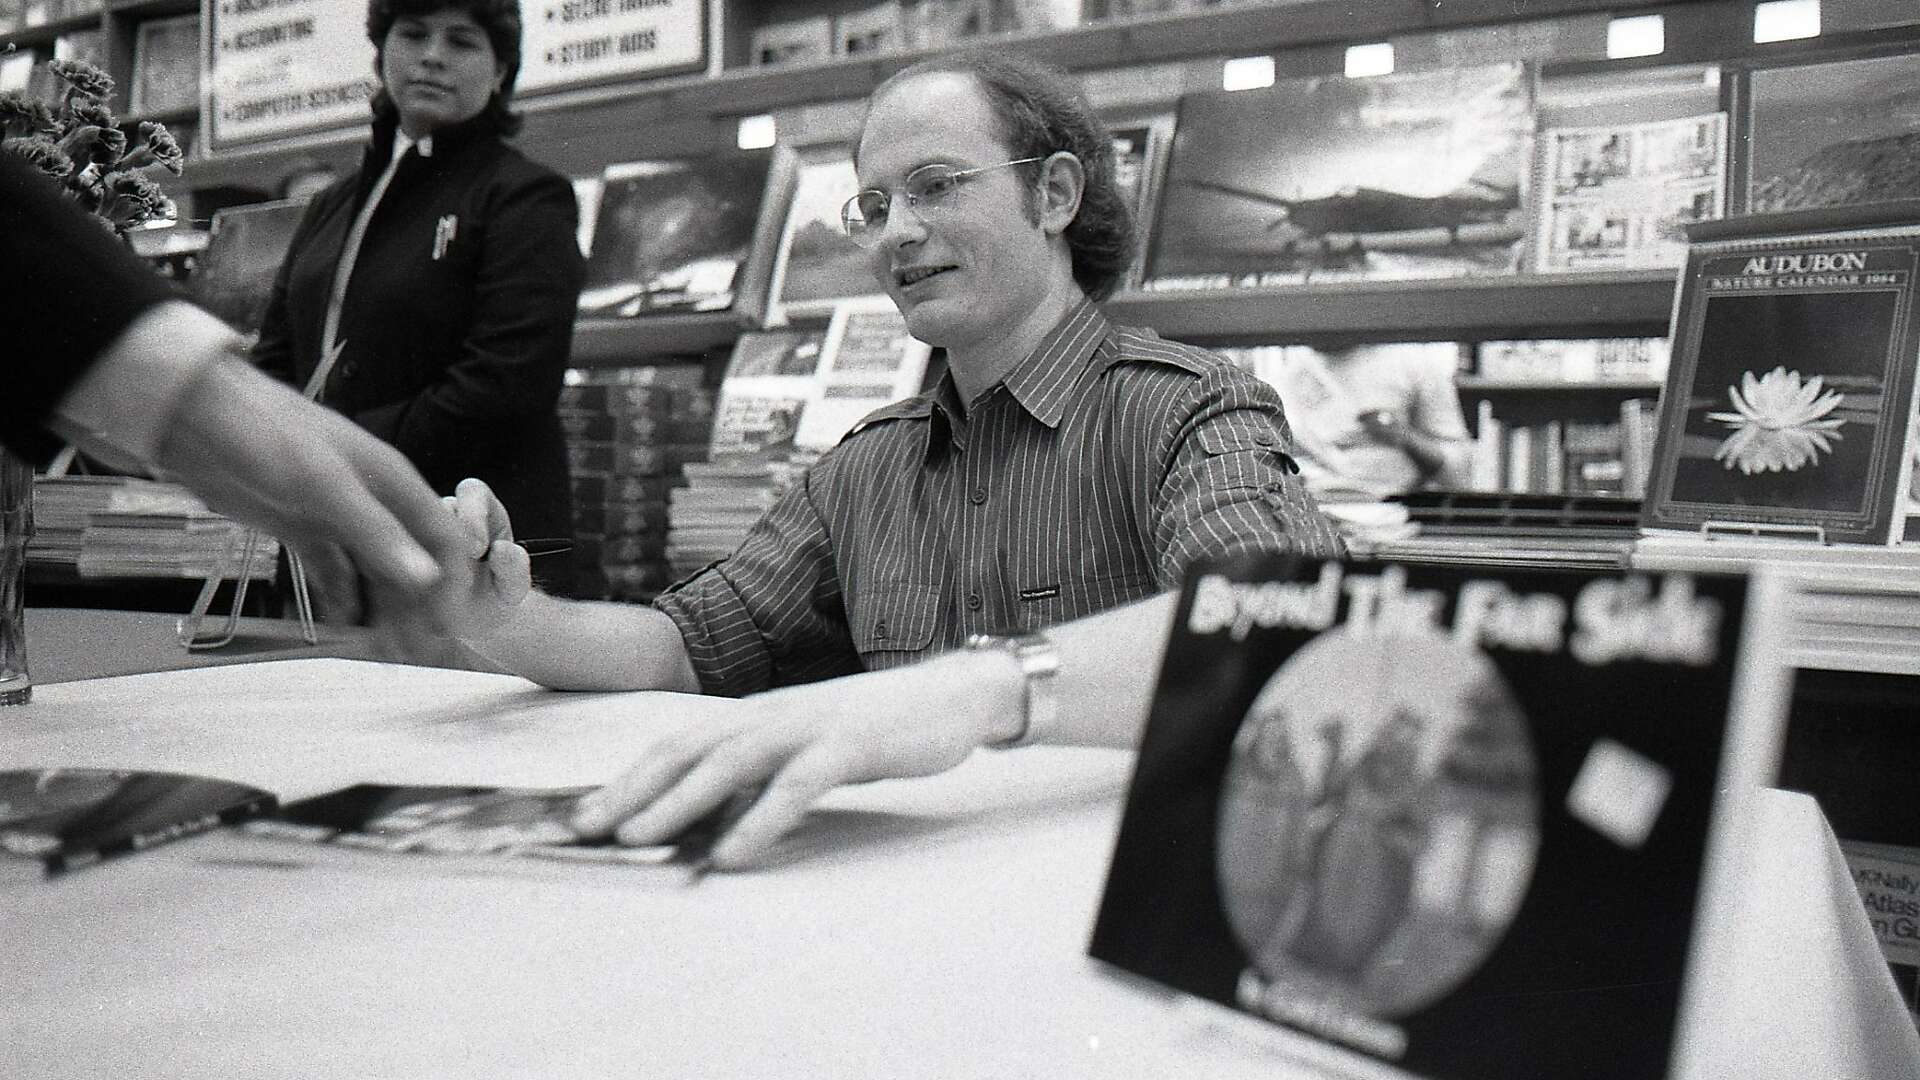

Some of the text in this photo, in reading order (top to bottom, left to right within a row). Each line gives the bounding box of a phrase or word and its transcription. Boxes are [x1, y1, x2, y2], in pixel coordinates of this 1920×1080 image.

[561, 29, 656, 64] STUDY AIDS
[235, 94, 301, 121] COMPUTER
[1742, 252, 1868, 275] AUDUBON
[1710, 277, 1773, 290] NATURE
[1776, 274, 1860, 288] CALENDAR
[1344, 565, 1446, 637] The
[1453, 579, 1568, 653] Far
[1570, 574, 1723, 667] Side
[1864, 892, 1919, 918] Atlas
